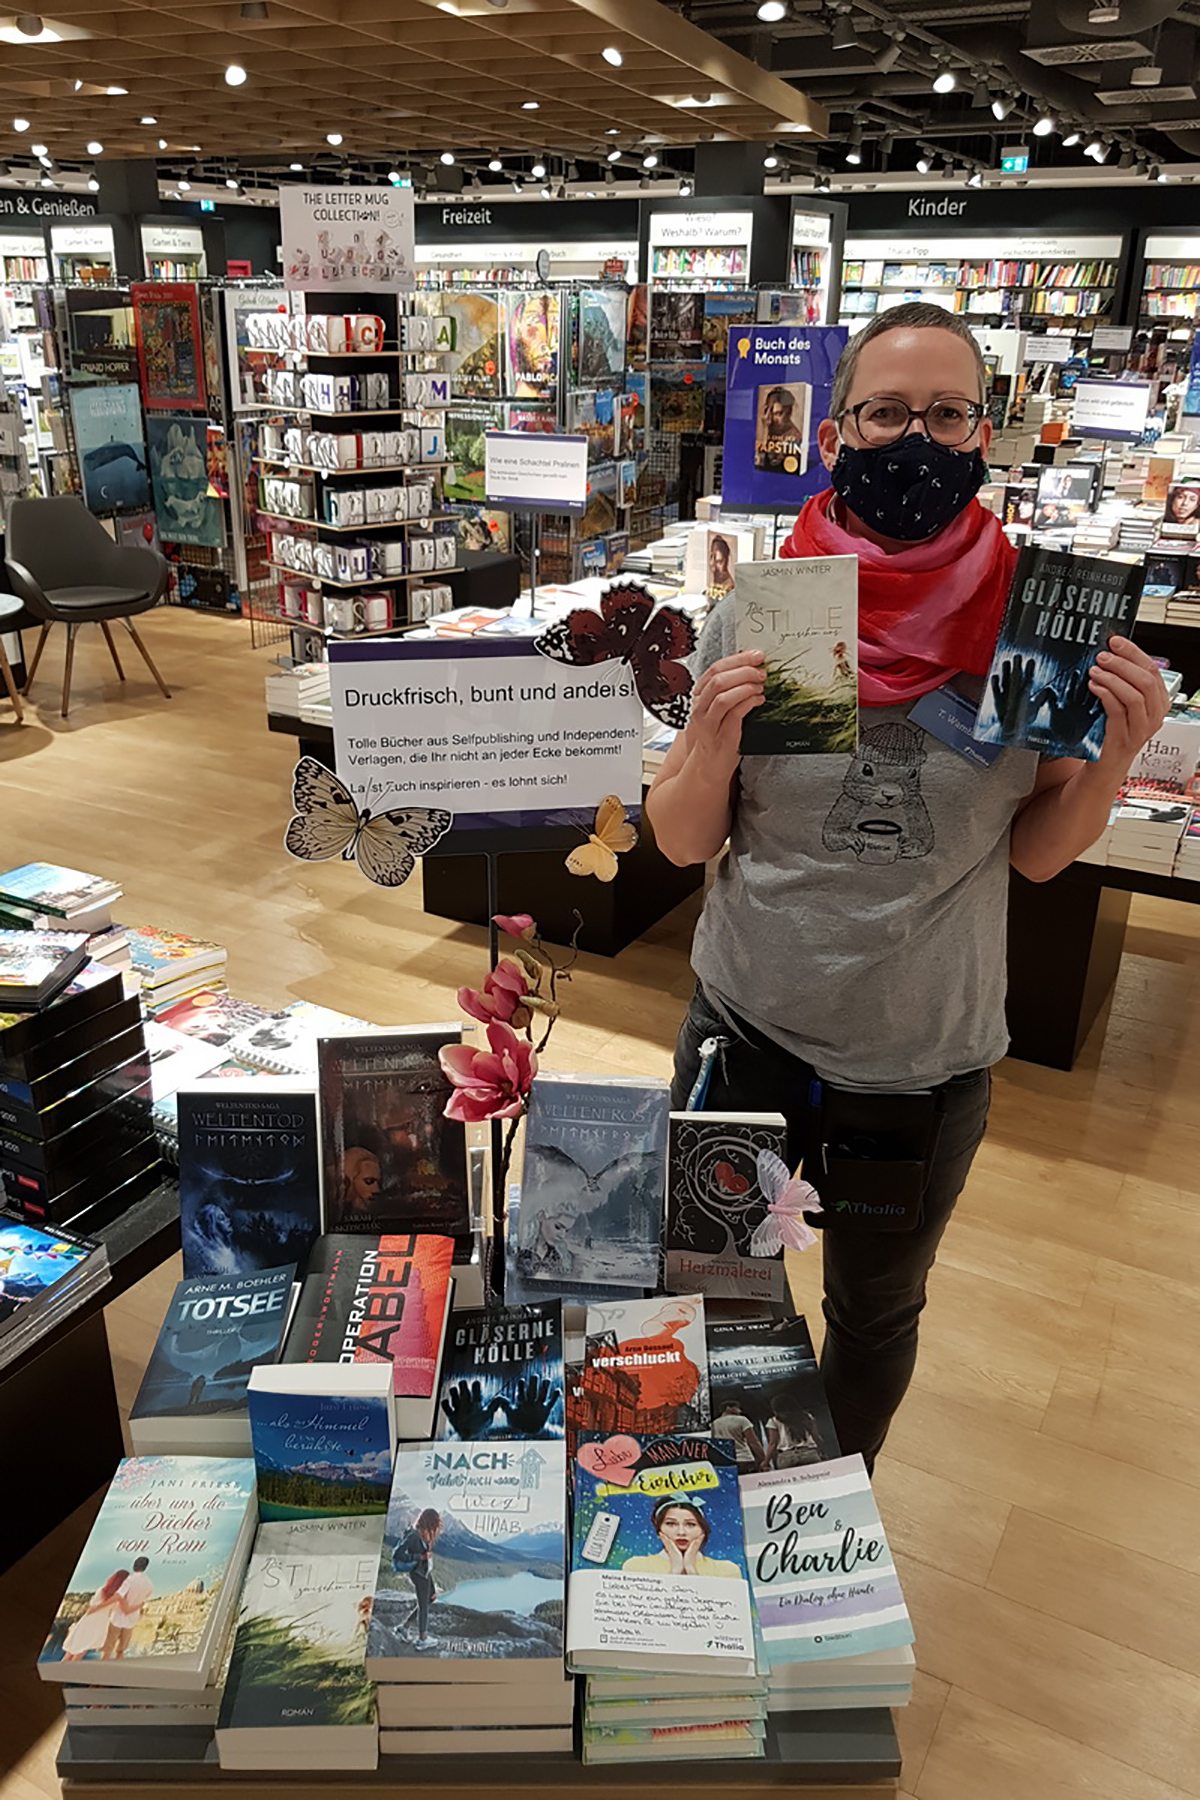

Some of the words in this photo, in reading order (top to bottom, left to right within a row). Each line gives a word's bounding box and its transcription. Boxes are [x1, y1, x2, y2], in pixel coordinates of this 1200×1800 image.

[17, 197, 30, 214] &
[32, 197, 95, 216] Genießen
[303, 193, 322, 205] THE
[325, 193, 362, 205] LETTER
[365, 193, 389, 205] MUG
[908, 198, 967, 216] Kinder
[443, 208, 492, 224] Freizeit
[661, 227, 703, 237] Weshalb?
[705, 226, 742, 237] Warum?
[437, 326, 450, 345] A
[755, 338, 786, 350] Buch
[788, 338, 811, 350] des
[755, 353, 801, 365] Monats
[515, 372, 542, 382] PABLO
[431, 380, 448, 400] M
[427, 435, 438, 456] J
[489, 457, 502, 465] Wie
[504, 458, 518, 466] eine
[519, 458, 551, 467] Schachtel
[553, 459, 580, 469] Pralinen
[761, 566, 793, 577] JASMIN
[795, 564, 832, 575] WINTER
[1039, 563, 1073, 578] ANDREA
[1076, 568, 1124, 586] REINHARDT
[1021, 577, 1131, 621] GLÄSERNE
[750, 606, 843, 634] STILLE
[1035, 609, 1103, 646] HÖLLE
[345, 686, 464, 707] Druckfrisch,
[471, 683, 513, 703] bunt
[520, 682, 556, 701] und
[938, 708, 947, 719] T.
[347, 738, 377, 749] Tolle
[380, 736, 423, 748] Bücher
[426, 737, 449, 746] aus
[452, 733, 534, 745] Selfpublishing
[537, 730, 559, 742] und
[563, 728, 638, 742] Independent-
[1147, 739, 1180, 756] Han
[348, 755, 406, 768] Verlagen,
[409, 753, 428, 763] die
[431, 752, 447, 762] Ihr
[450, 750, 479, 761] nicht
[481, 751, 497, 761] an
[499, 748, 529, 762] jeder
[532, 747, 562, 758] Ecke
[565, 744, 622, 757] bekommt!
[419, 779, 481, 792] inspirieren
[491, 779, 506, 788] es
[509, 776, 538, 788] lohnt
[541, 774, 568, 786] sich!
[191, 1112, 305, 1128] WELTENTOD
[852, 1201, 906, 1215] Thalia
[680, 1258, 772, 1281] Herzmalerei
[184, 1283, 216, 1295] ARNE
[218, 1282, 233, 1291] M.
[236, 1273, 287, 1290] BOEHLER
[178, 1288, 286, 1321] TOTSEE
[339, 1250, 379, 1364] OPERATION
[455, 1318, 554, 1346] GLÄSERNE
[473, 1341, 535, 1365] HÖLLE
[624, 1345, 642, 1353] Arne
[592, 1351, 681, 1369] verschluckt
[711, 1359, 729, 1369] AH
[734, 1357, 760, 1366] WIE
[763, 1351, 799, 1363] FERN
[710, 1371, 747, 1381] ÖDLICHE
[750, 1365, 798, 1376] WAHRHEIT
[304, 1414, 370, 1431] Himmel
[285, 1434, 343, 1452] berührte
[432, 1452, 509, 1470] NACH
[592, 1447, 633, 1472] Liebe
[646, 1440, 709, 1464] MÄNNER
[150, 1478, 183, 1489] JANI
[191, 1480, 241, 1489] FRIESE
[757, 1477, 792, 1487] Alexandra
[129, 1492, 163, 1510] über
[168, 1500, 196, 1511] uns
[202, 1495, 226, 1511] die
[142, 1511, 212, 1531] Dächer
[766, 1494, 829, 1533] Ben
[287, 1523, 325, 1535] JASMIN
[327, 1520, 367, 1531] WINTER
[834, 1519, 843, 1531] &
[116, 1538, 150, 1552] von
[154, 1533, 208, 1555] Rom
[756, 1527, 884, 1583] Charlie
[263, 1560, 375, 1589] STILLE
[779, 1596, 793, 1608] Ein
[794, 1593, 825, 1608] Dialog
[826, 1587, 846, 1601] ohne
[714, 1641, 745, 1651] Thalia
[281, 1708, 314, 1716] ROMAN
